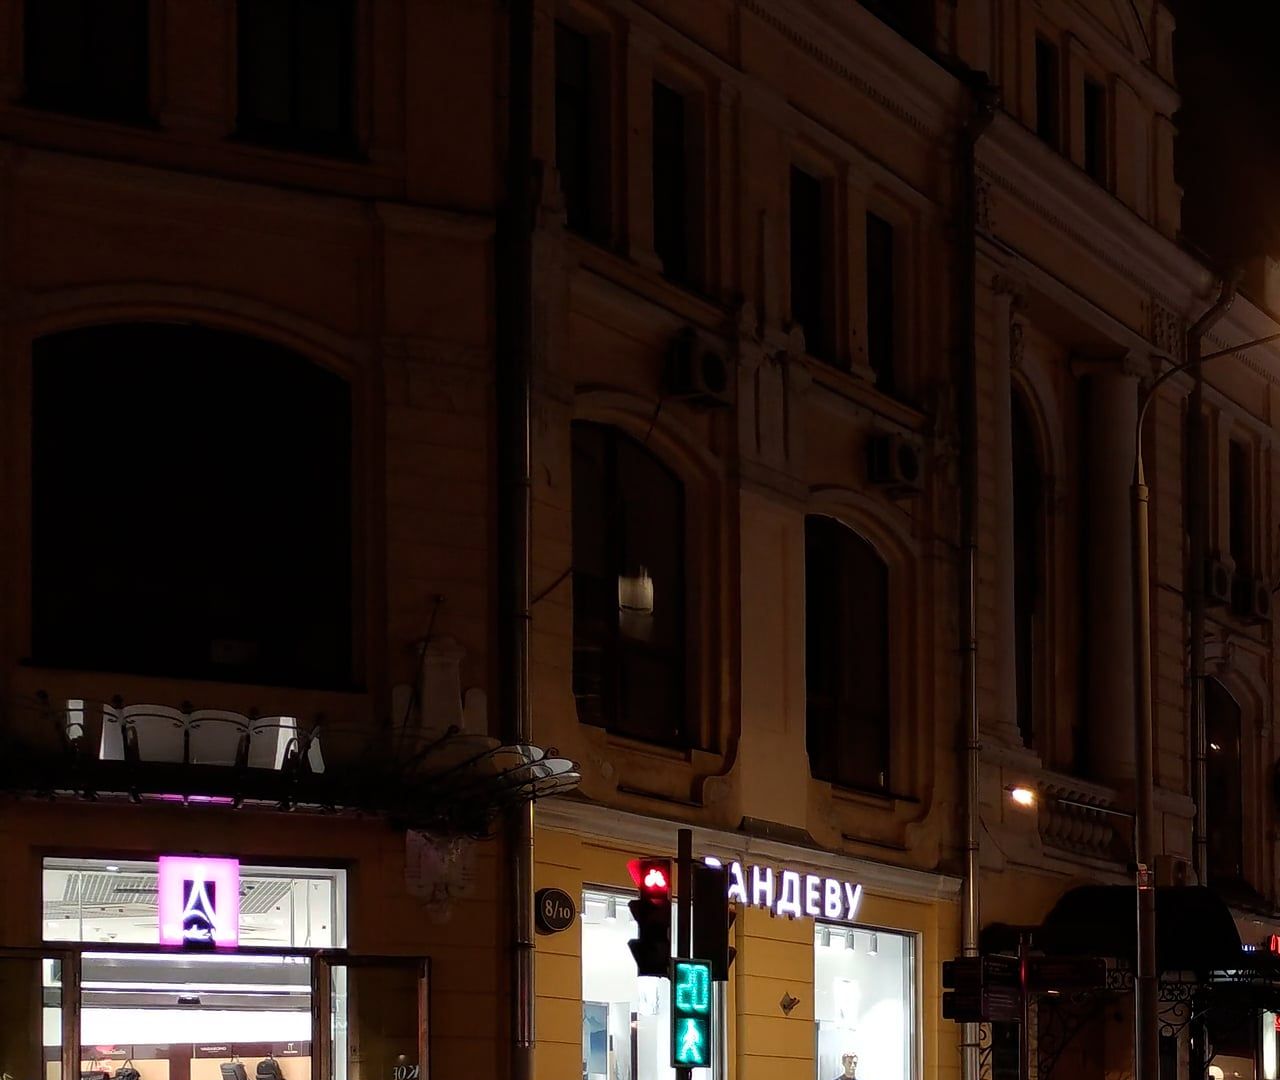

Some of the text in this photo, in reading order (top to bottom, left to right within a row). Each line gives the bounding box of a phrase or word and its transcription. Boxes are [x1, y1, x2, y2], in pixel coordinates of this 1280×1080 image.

[545, 899, 570, 919] 8/10
[704, 857, 862, 919] АНДЕВУ
[676, 963, 709, 1011] 20
